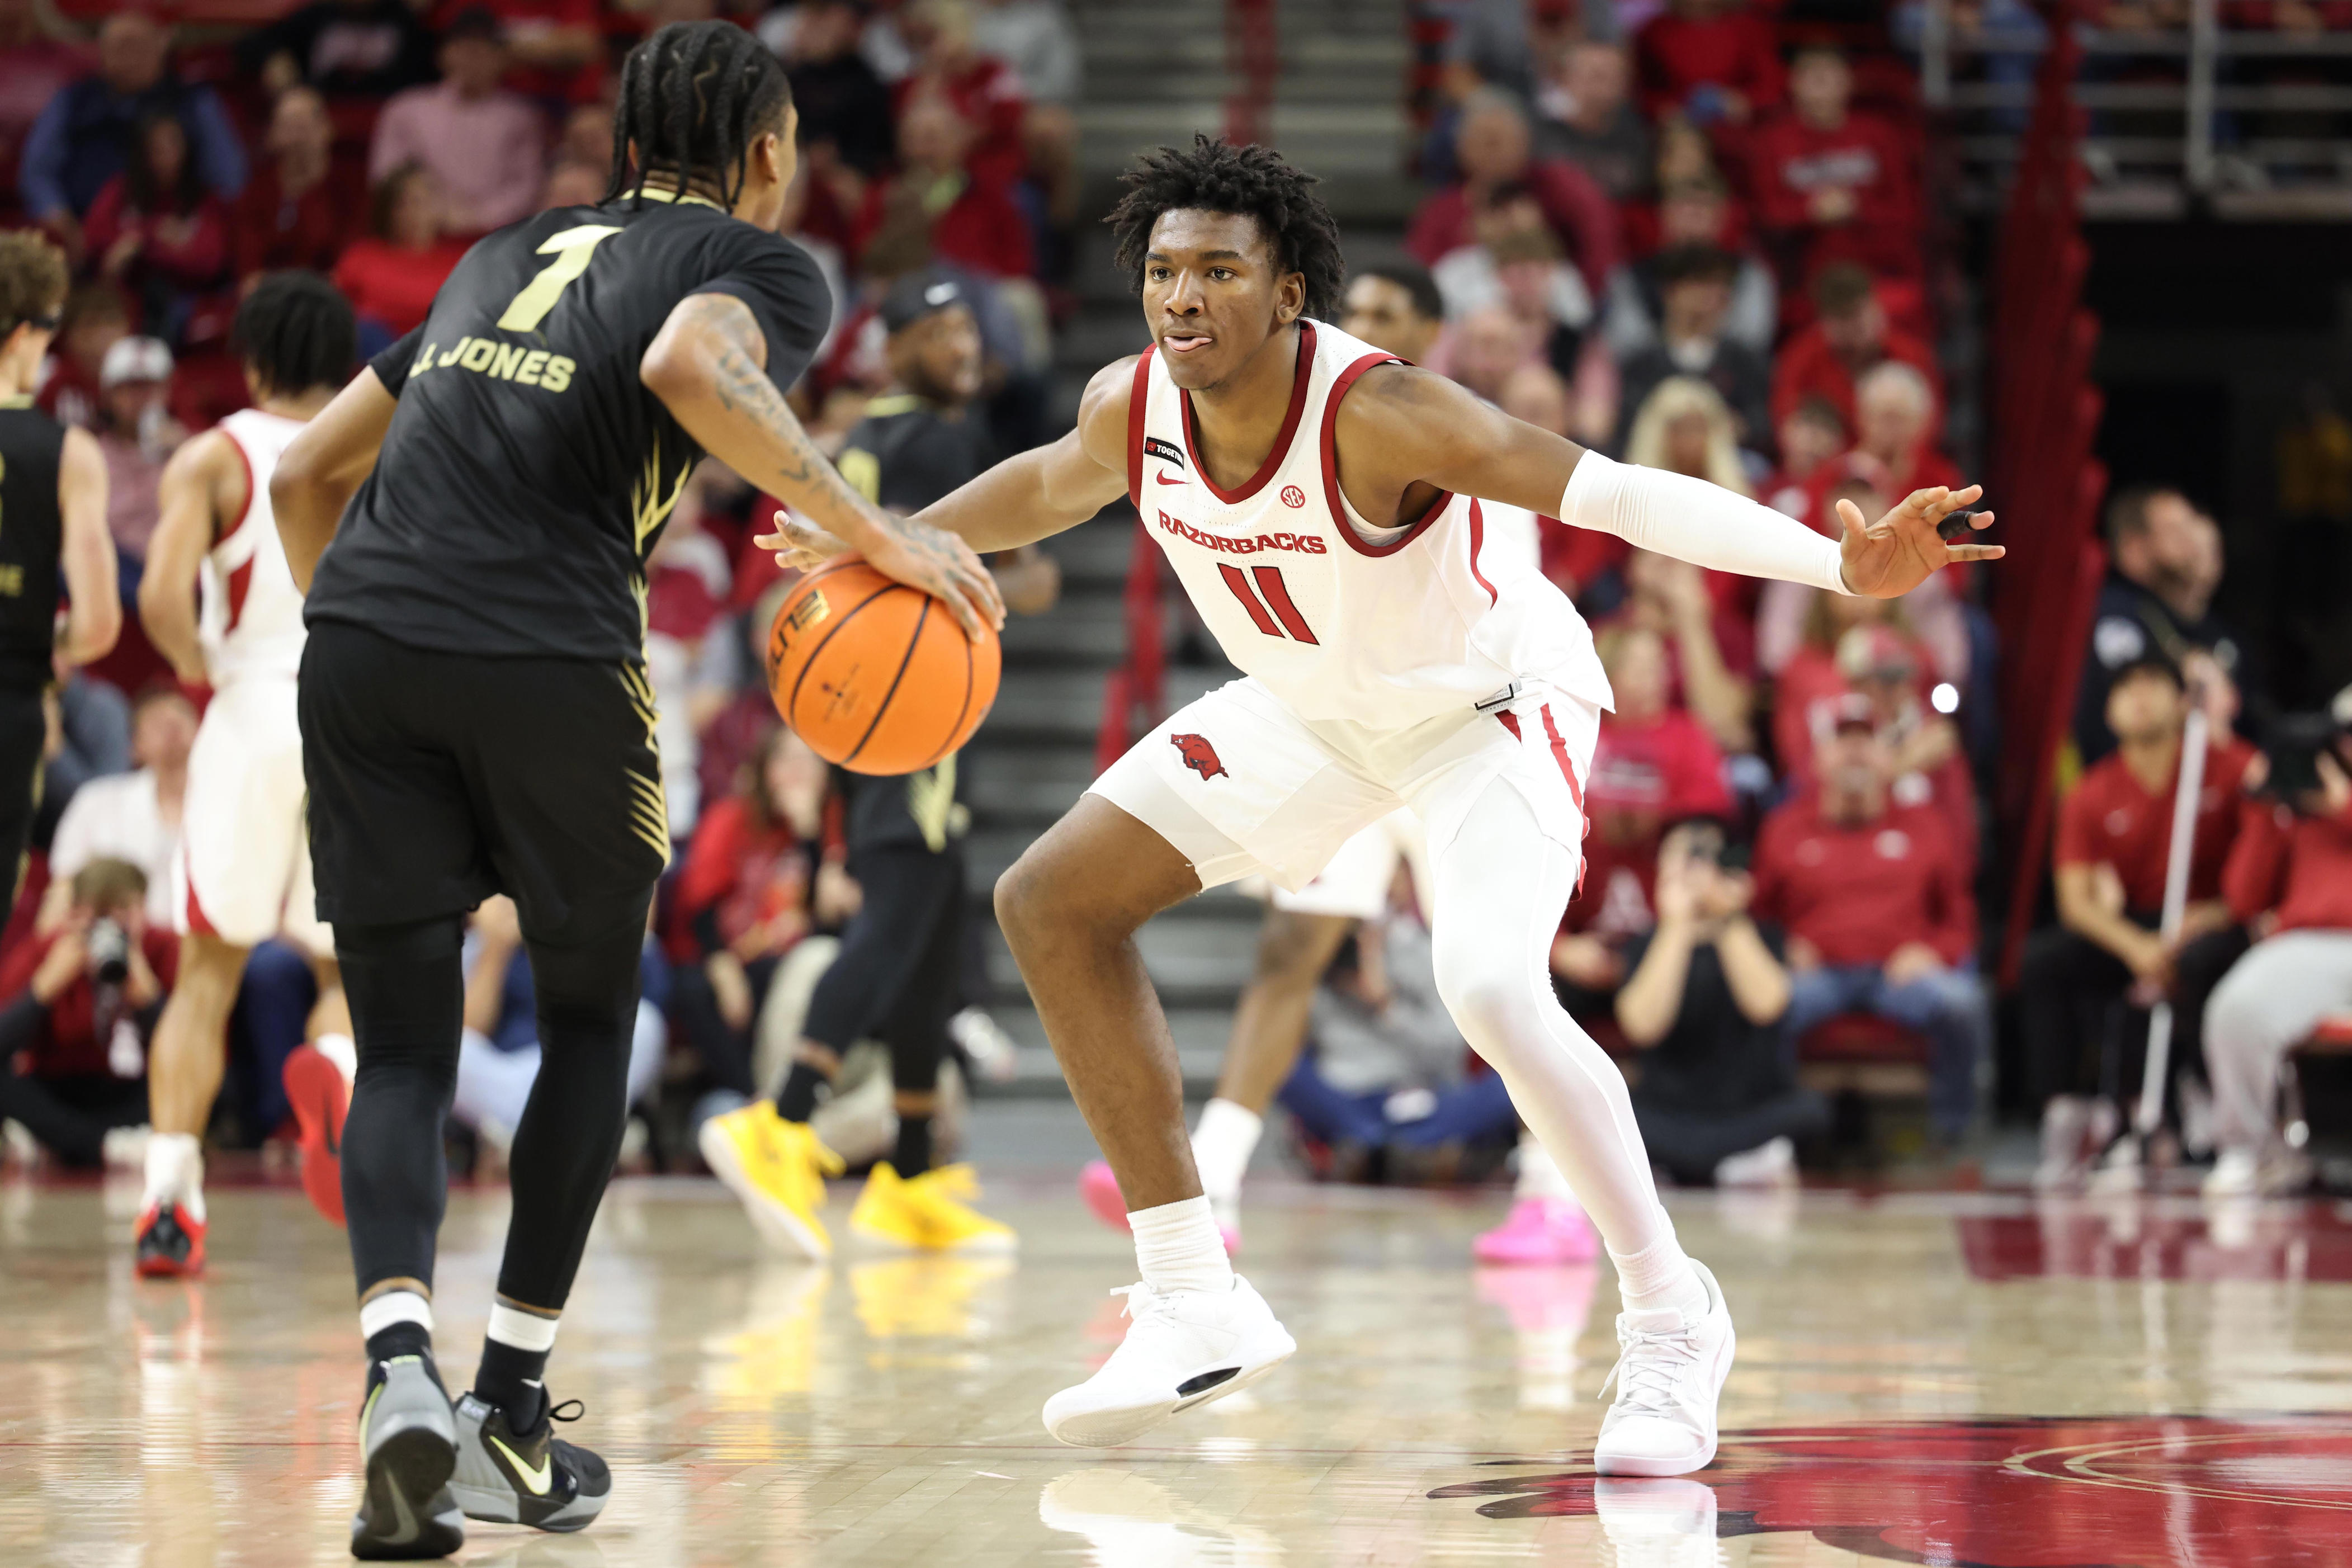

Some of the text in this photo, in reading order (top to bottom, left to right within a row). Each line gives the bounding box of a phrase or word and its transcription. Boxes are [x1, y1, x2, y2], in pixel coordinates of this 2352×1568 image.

[437, 336, 576, 393] JONES
[1282, 488, 1303, 507] SEC
[1158, 508, 1327, 554] RAZORBACKS
[1216, 563, 1320, 645] 11
